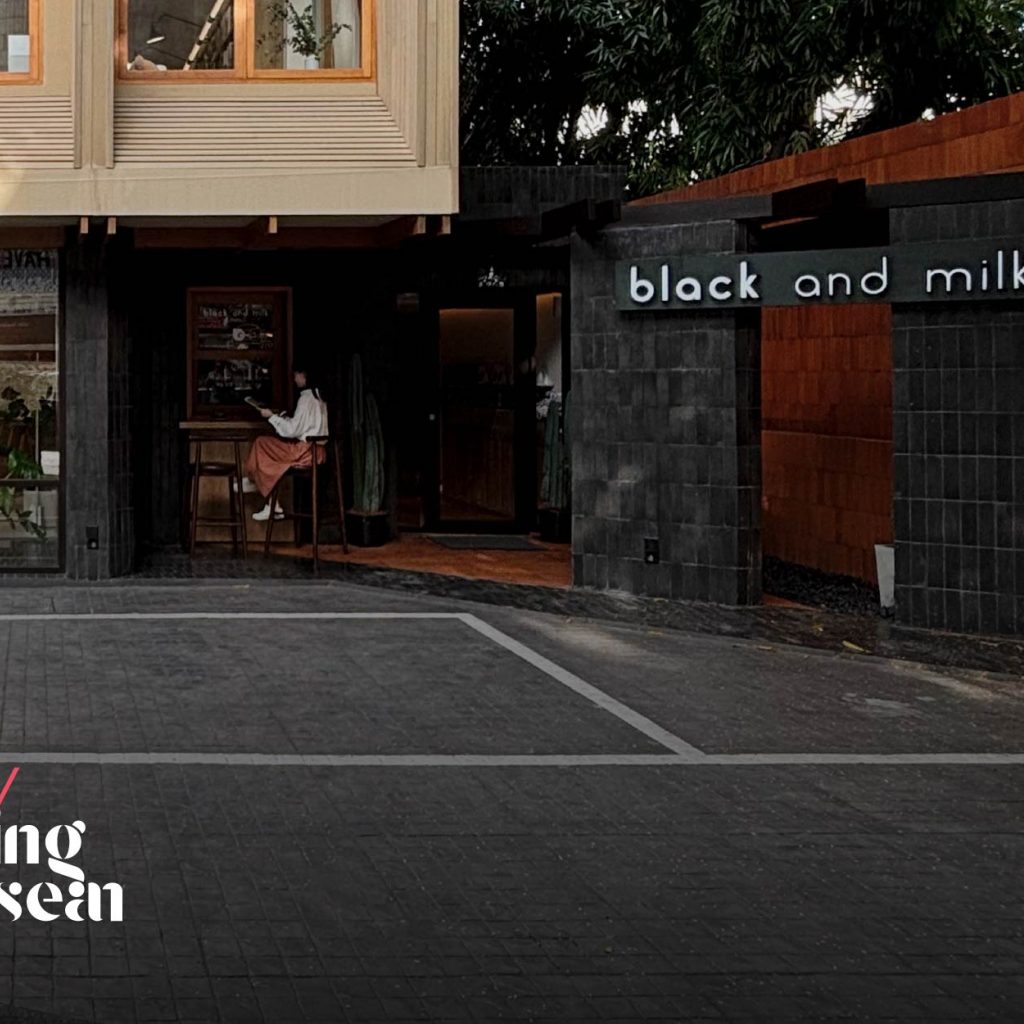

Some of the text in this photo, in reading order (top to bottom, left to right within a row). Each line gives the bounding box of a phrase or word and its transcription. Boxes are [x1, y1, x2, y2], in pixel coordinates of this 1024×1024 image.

[629, 250, 1024, 304] black and milk
